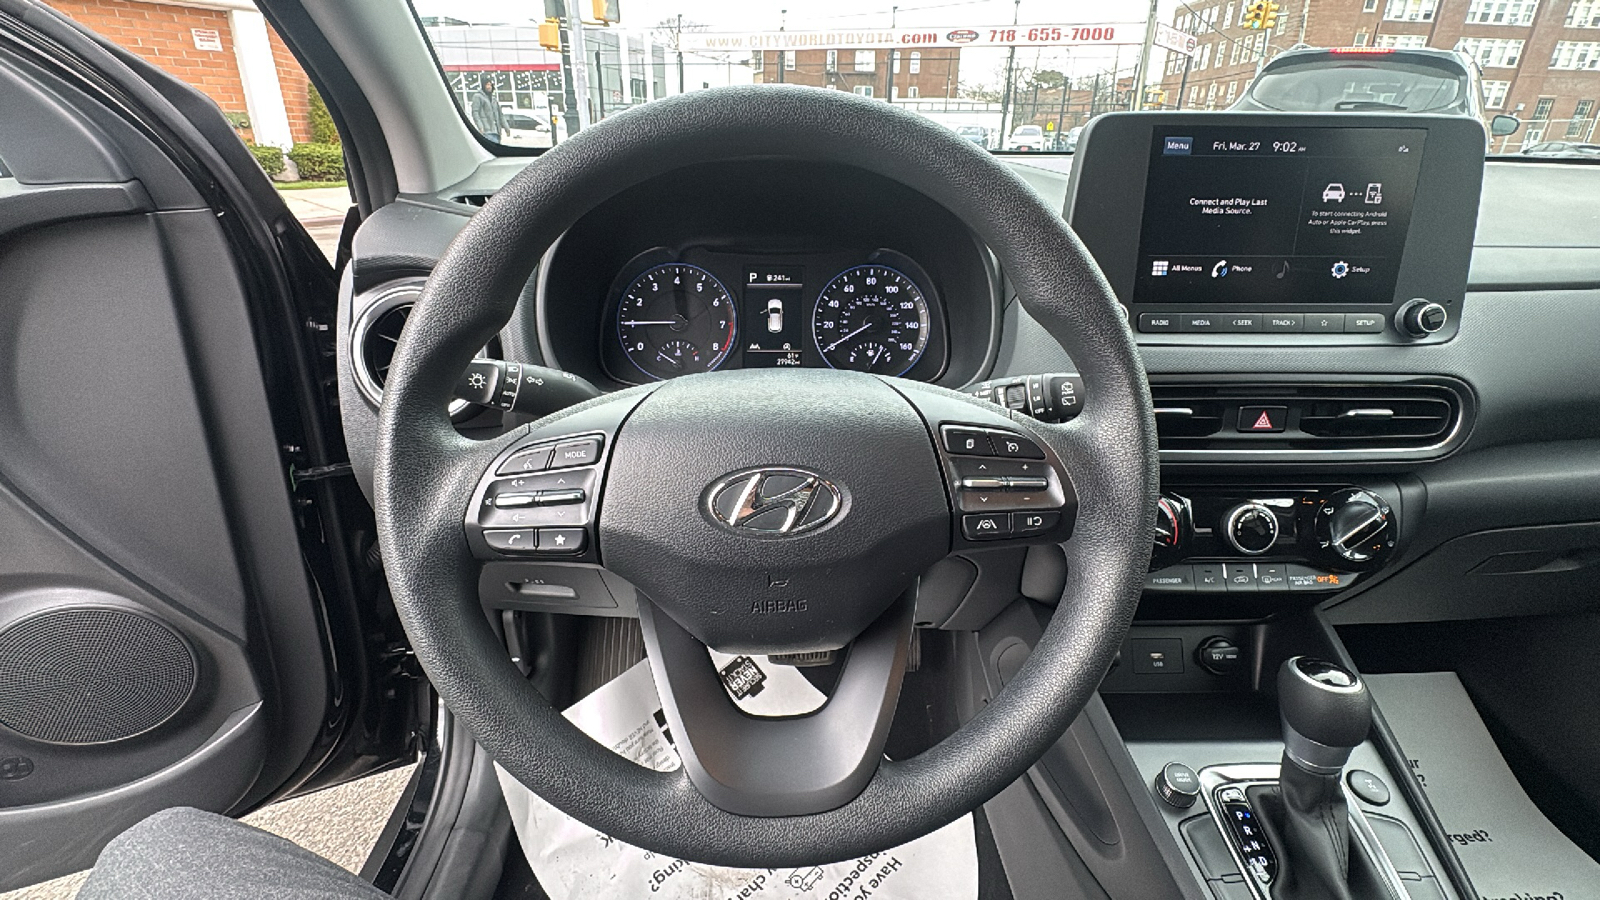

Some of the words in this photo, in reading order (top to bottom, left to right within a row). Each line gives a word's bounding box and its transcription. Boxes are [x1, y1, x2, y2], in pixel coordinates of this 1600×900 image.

[1167, 141, 1189, 150] Menu
[1213, 141, 1227, 151] Fri.
[1229, 141, 1247, 150] Mar.
[1248, 141, 1261, 150] 27
[1273, 141, 1298, 152] 9:02
[1189, 197, 1219, 206] Connect
[1220, 198, 1234, 206] and
[1234, 198, 1251, 207] Play
[1202, 206, 1224, 215] Media
[1225, 207, 1253, 215] Source.
[1171, 264, 1181, 272] All
[1181, 264, 1203, 273] Menus
[1231, 264, 1253, 273] Phone
[1351, 266, 1371, 275] Setup
[673, 276, 681, 285] 4
[749, 272, 758, 283] P
[866, 277, 877, 286] 80
[652, 282, 659, 292] 3
[696, 282, 703, 293] 5
[843, 284, 854, 293] 60
[885, 285, 899, 294] 100
[636, 298, 643, 307] 2
[712, 298, 720, 308] 6
[828, 300, 840, 308] 40
[719, 320, 726, 329] 7
[823, 321, 834, 329] 20
[905, 321, 919, 329] 140
[1151, 319, 1170, 327] RADIO
[1191, 319, 1211, 327] MEDIA
[1356, 319, 1376, 327] SETUP
[636, 342, 644, 351] 0
[712, 342, 719, 351] 8
[900, 342, 913, 351] 160
[565, 450, 587, 459] MODE
[751, 599, 808, 614] AIRBAG
[729, 665, 758, 690] NEVER
[1236, 811, 1243, 820] P
[1243, 825, 1253, 835] R
[1250, 840, 1260, 850] N
[1258, 856, 1268, 866] D
[868, 855, 903, 890] Have
